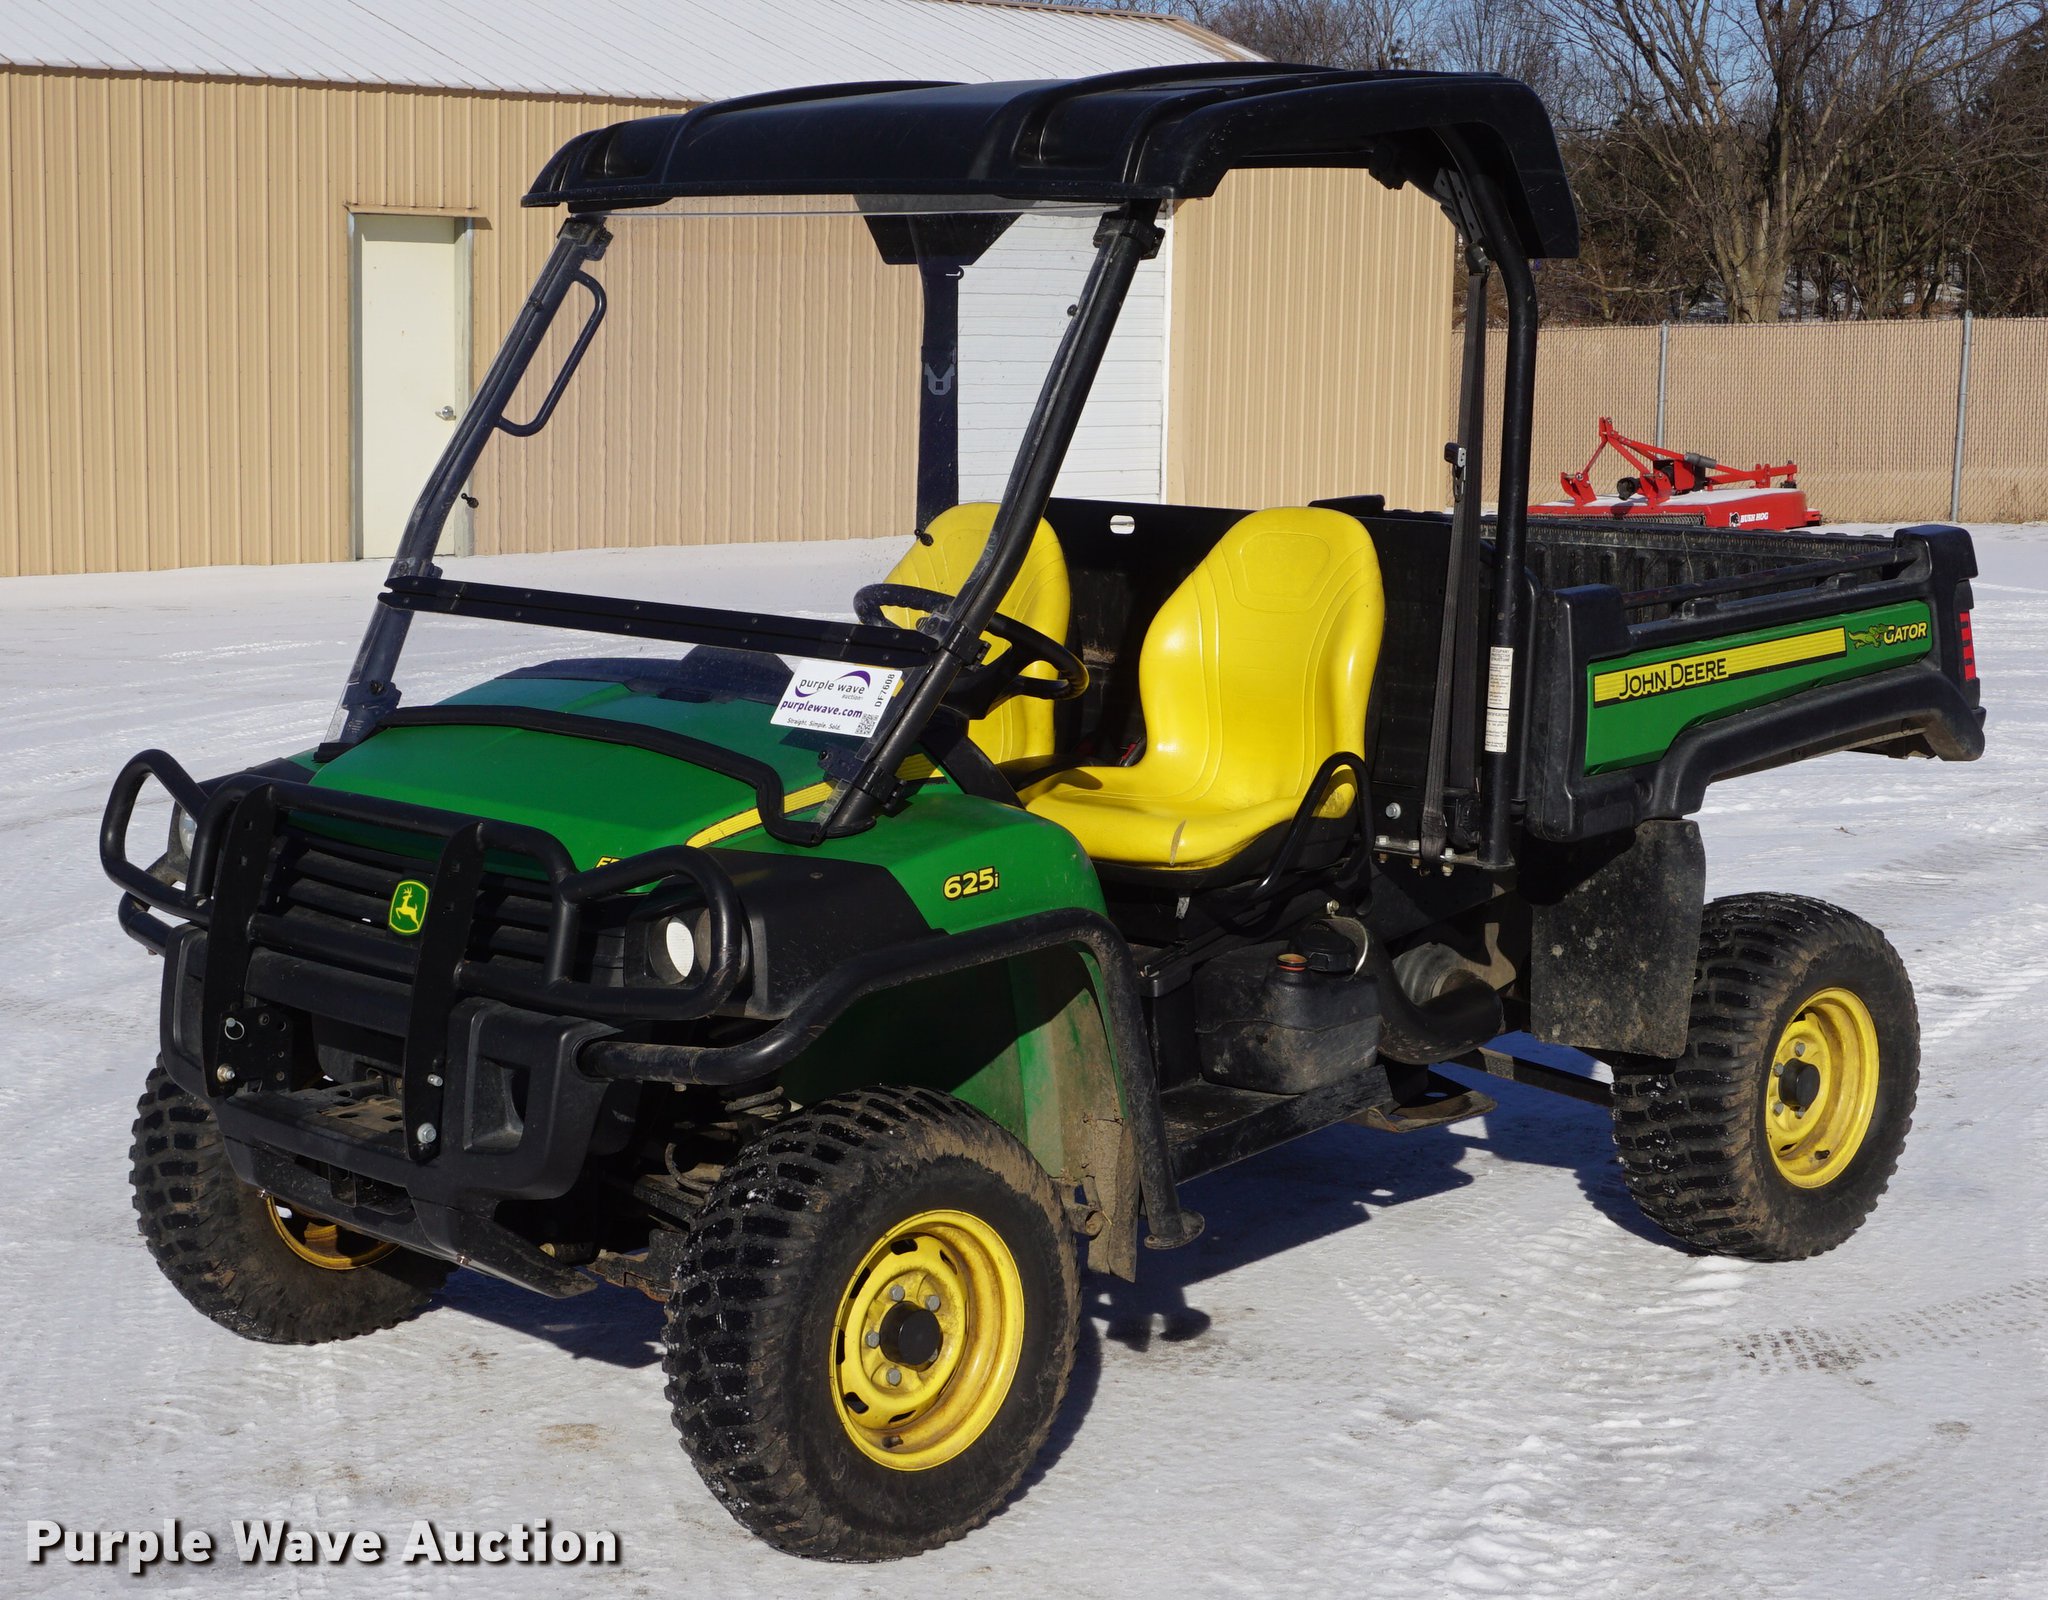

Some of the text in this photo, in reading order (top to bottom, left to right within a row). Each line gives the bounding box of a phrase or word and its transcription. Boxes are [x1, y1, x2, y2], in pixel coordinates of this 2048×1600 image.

[1883, 622, 1927, 644] GATOR
[799, 679, 865, 694] purple wave
[875, 673, 895, 707] DF7608
[1619, 658, 1727, 697] JOHN DEERE
[781, 700, 862, 718] purplewave.com
[943, 867, 999, 900] 625i
